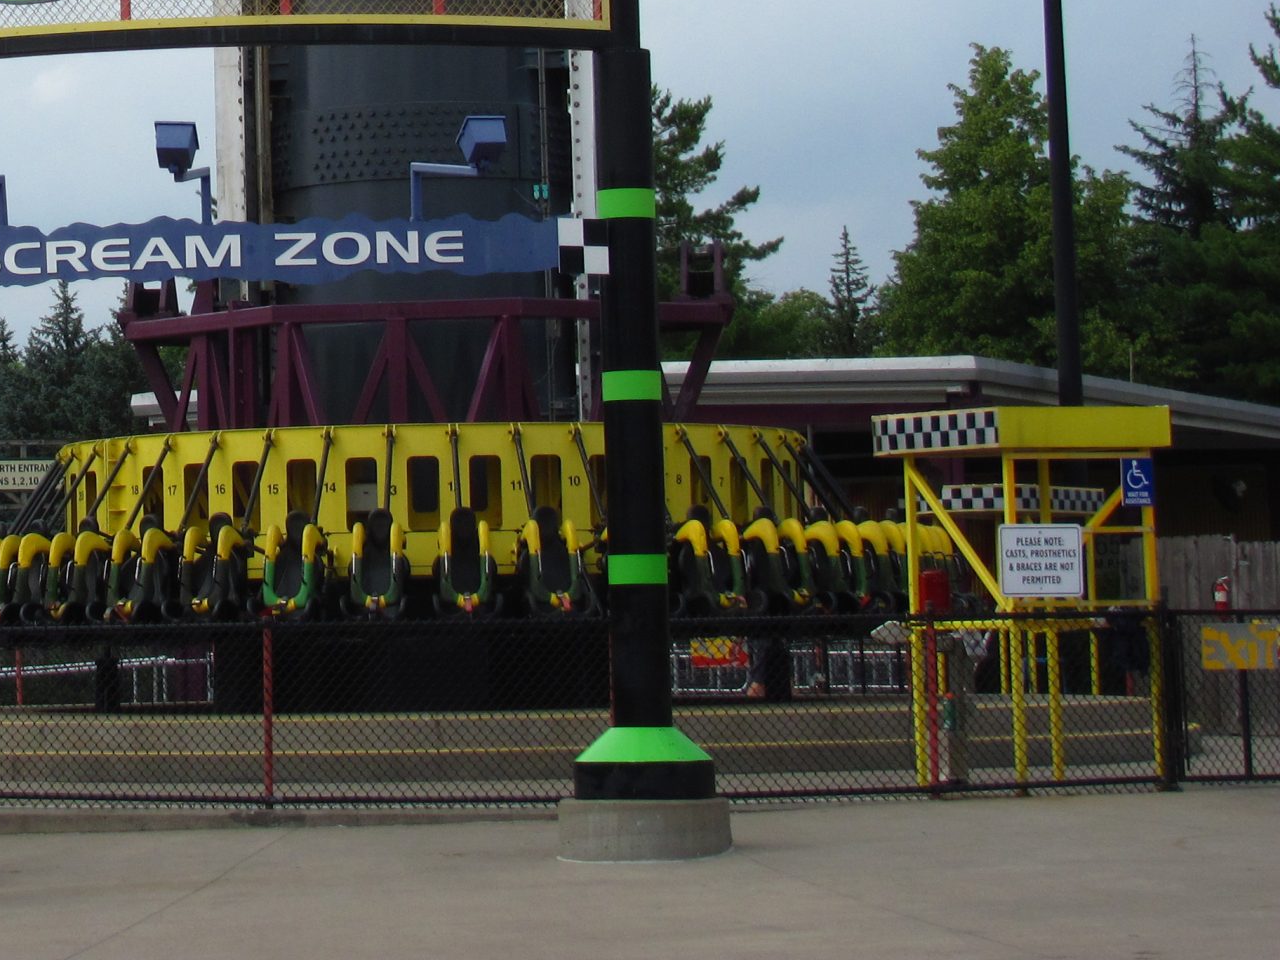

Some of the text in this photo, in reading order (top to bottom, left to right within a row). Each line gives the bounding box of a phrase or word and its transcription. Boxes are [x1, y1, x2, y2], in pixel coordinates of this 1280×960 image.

[274, 228, 466, 266] ZONE
[568, 476, 580, 486] 10
[676, 474, 682, 484] 8
[215, 484, 226, 494] 16
[267, 484, 279, 494] 15
[324, 482, 336, 492] 14
[510, 480, 521, 490] 11
[131, 486, 139, 495] 18
[167, 486, 177, 496] 17
[1016, 537, 1064, 546] PLEASE NOTE:
[1005, 549, 1077, 559] CASTS, PROSTHETICS
[1009, 562, 1074, 571] & BRACES ARE NOT
[1022, 575, 1062, 585] PERMITTED
